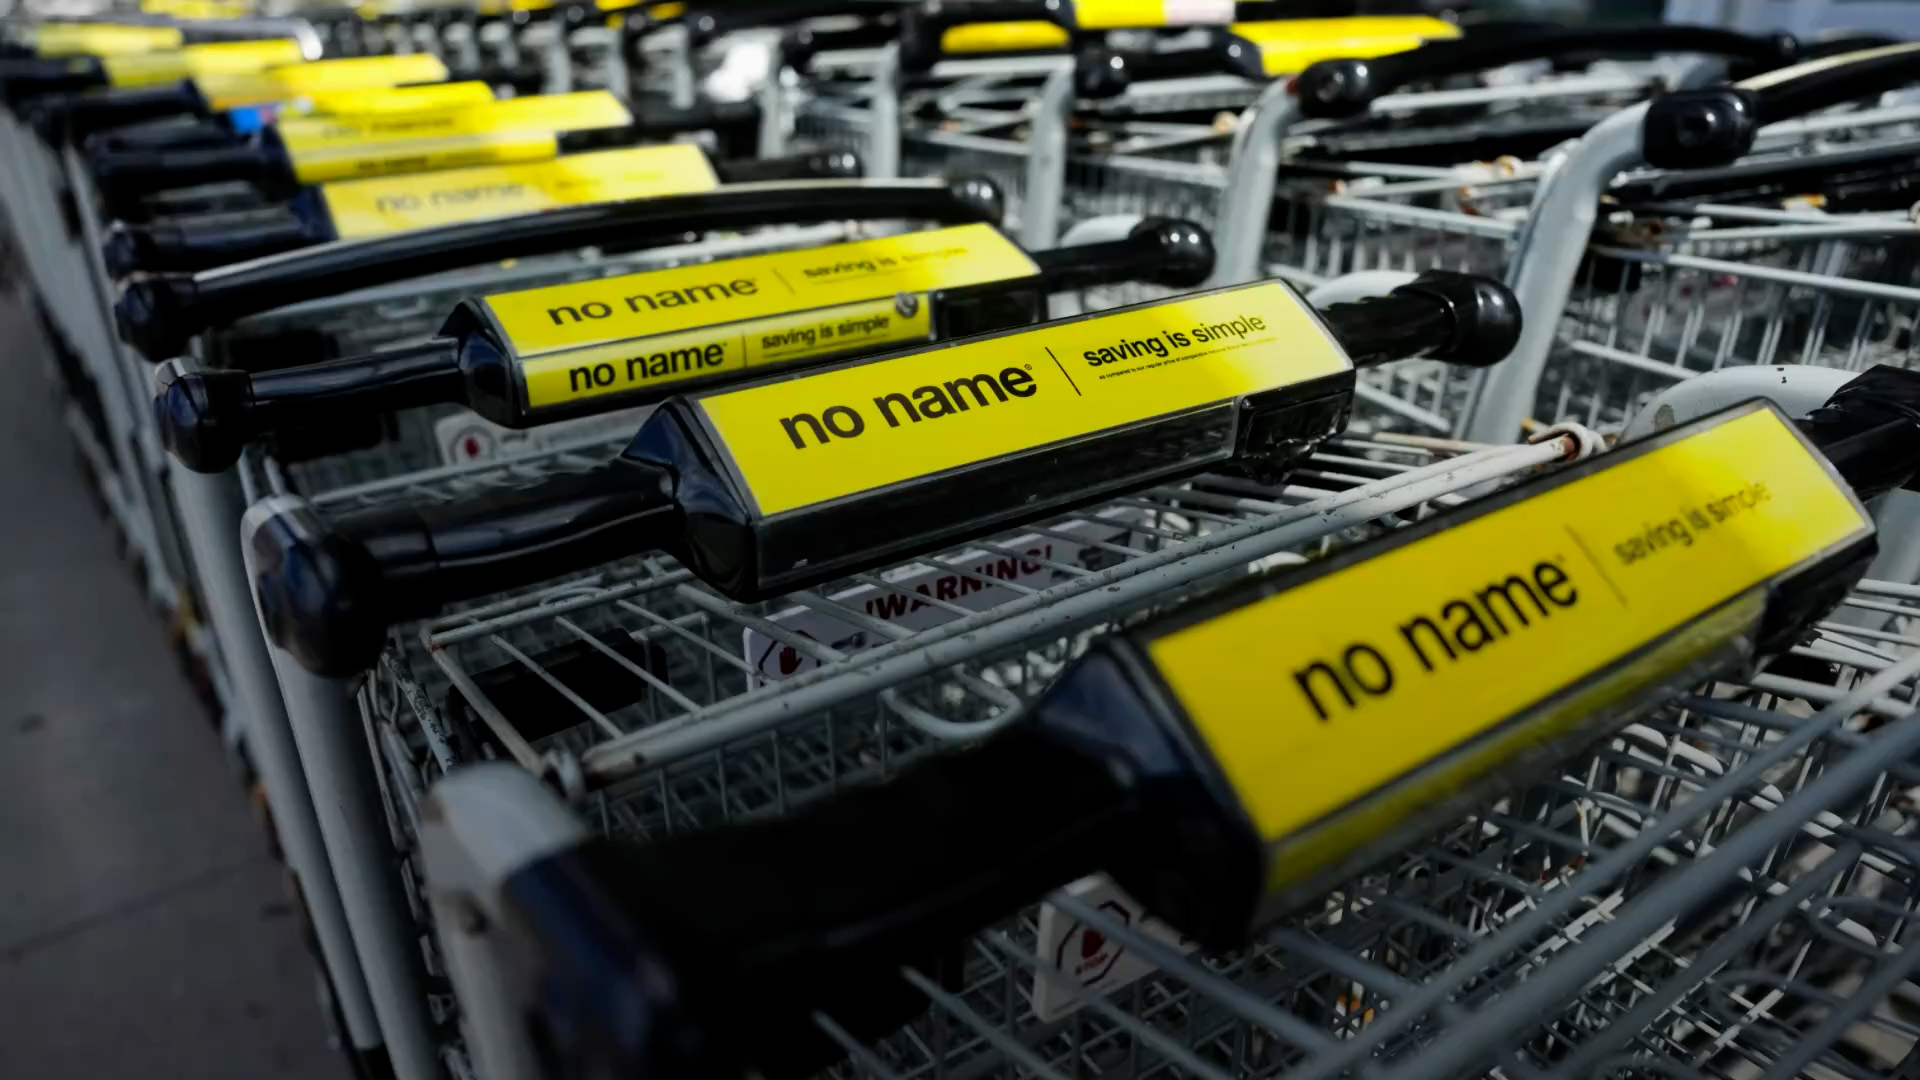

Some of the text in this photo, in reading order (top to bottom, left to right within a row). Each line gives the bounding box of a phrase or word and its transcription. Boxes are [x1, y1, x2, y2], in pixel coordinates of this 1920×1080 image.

[547, 278, 759, 325] no name
[762, 327, 816, 350] saving
[819, 323, 834, 340] is
[838, 314, 890, 337] simple
[1083, 339, 1169, 367] saving
[1162, 330, 1191, 349] is
[1191, 314, 1267, 343] simple
[569, 361, 616, 392] no
[626, 343, 724, 381] name
[779, 405, 865, 450] no
[1613, 520, 1695, 565] saving
[1292, 560, 1578, 721] no name
